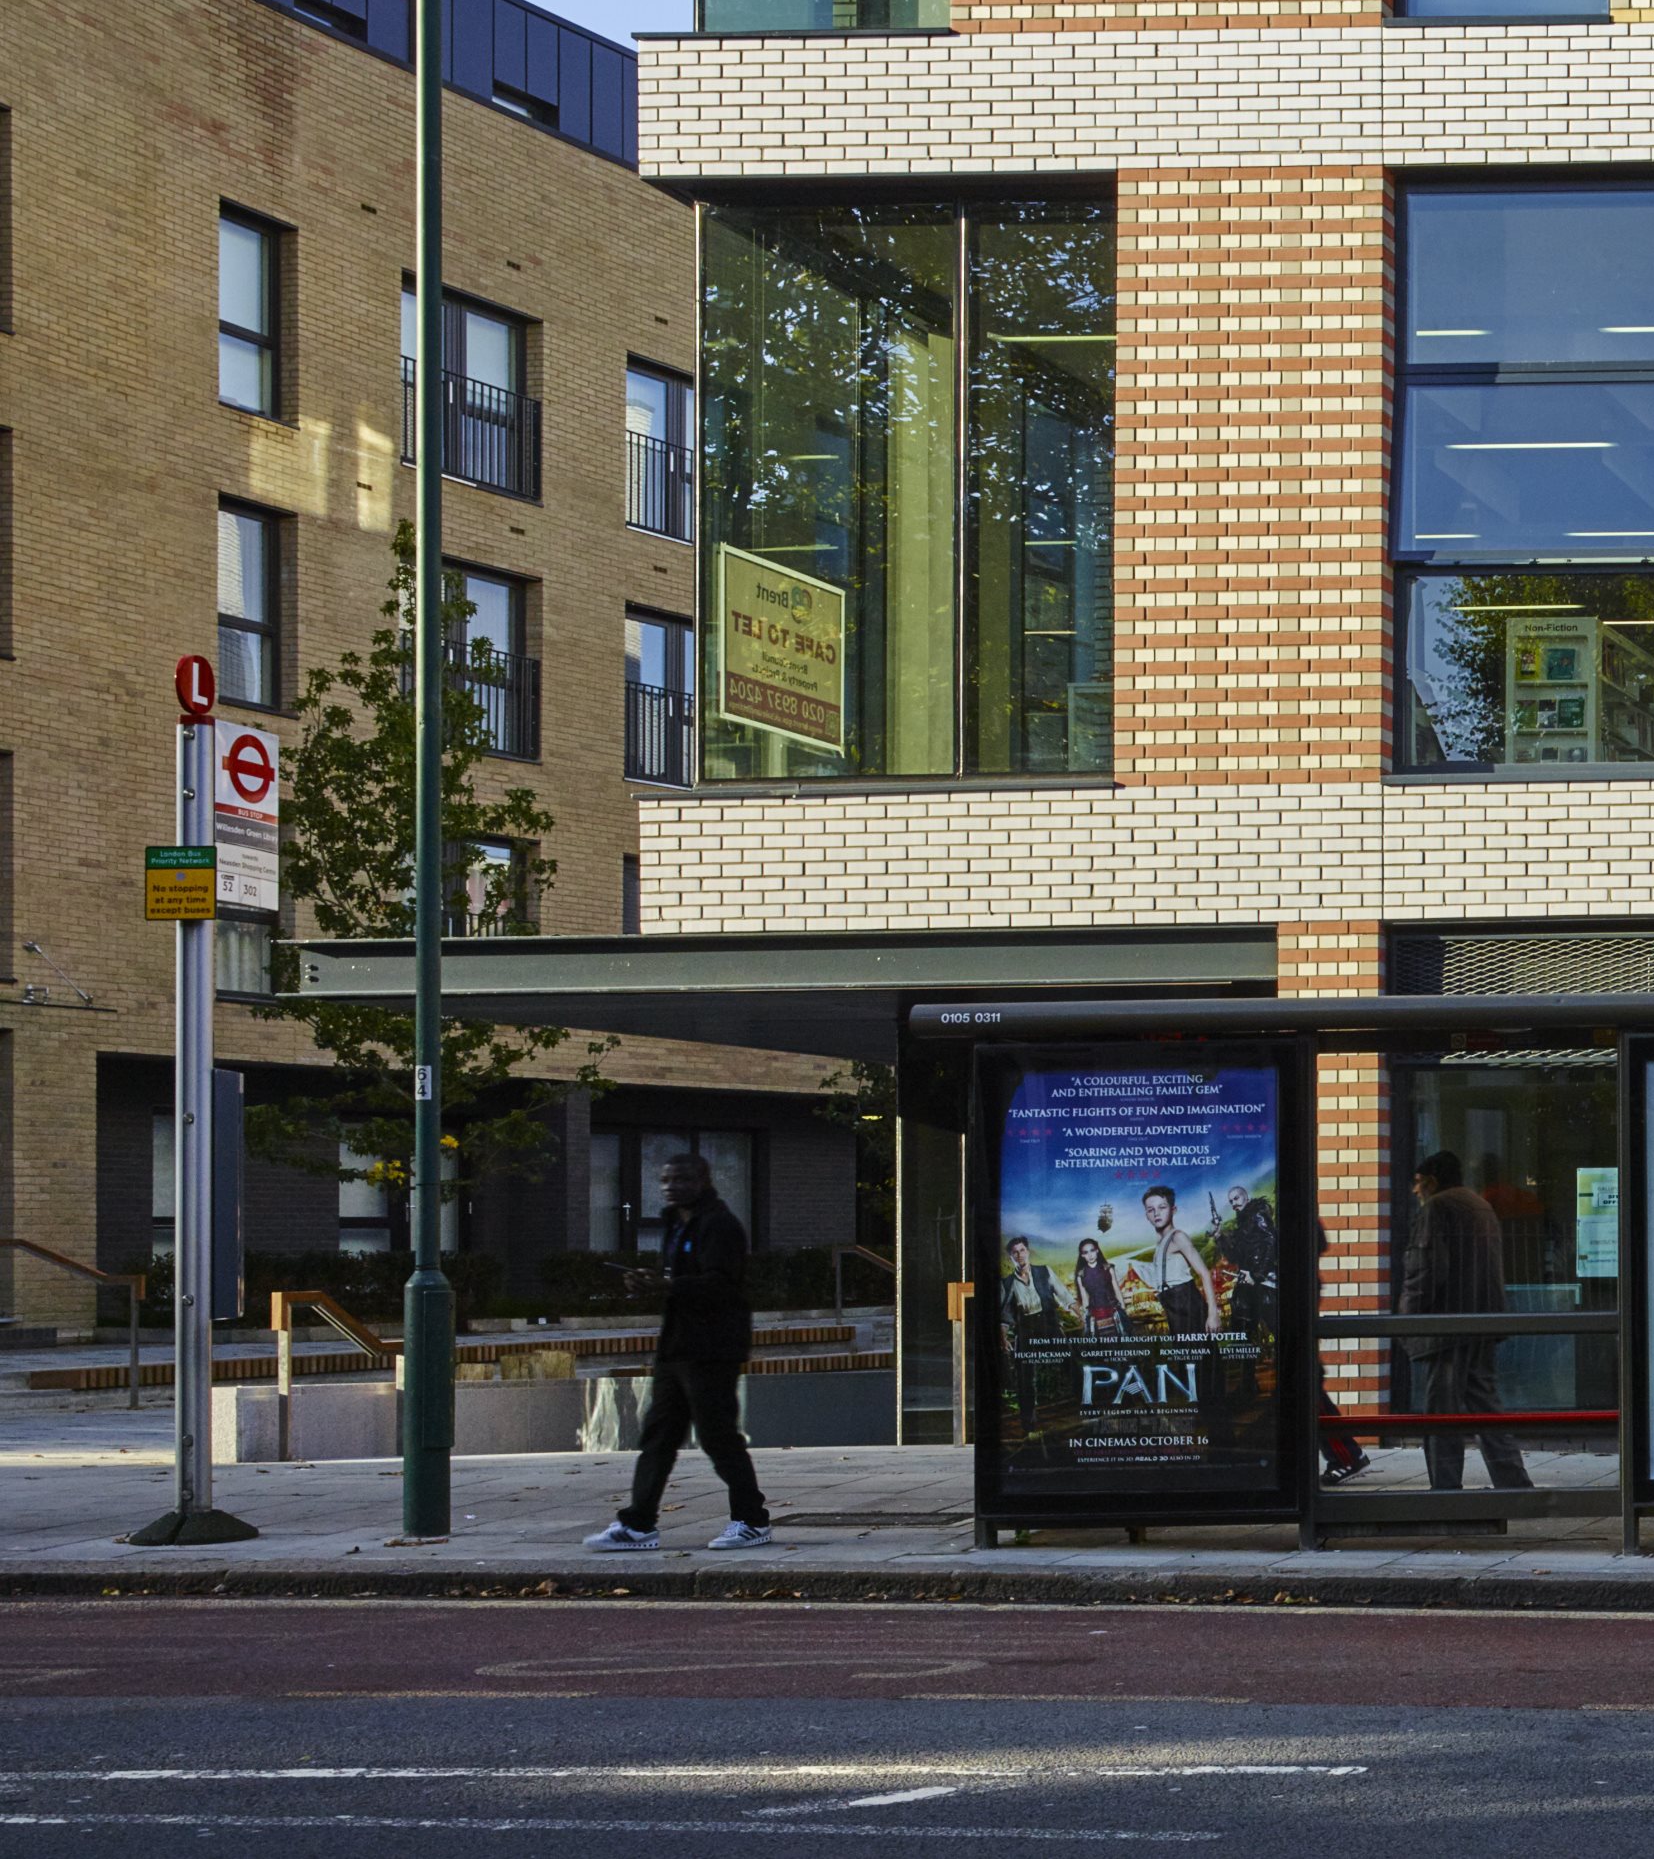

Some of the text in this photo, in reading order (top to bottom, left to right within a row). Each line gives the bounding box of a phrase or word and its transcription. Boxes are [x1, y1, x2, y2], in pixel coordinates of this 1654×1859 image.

[1525, 623, 1578, 632] Non-Fiction
[192, 661, 208, 706] L
[238, 808, 263, 819] BUS STOP
[215, 822, 245, 836] Willesden
[246, 828, 262, 839] Green
[242, 862, 262, 873] Shopping
[152, 884, 209, 893] No stopping
[223, 881, 233, 892] 52
[243, 884, 257, 896] 302
[167, 897, 183, 905] any
[186, 896, 207, 904] time
[150, 906, 211, 914] except buses
[941, 1012, 1001, 1023] 0105 0311
[1152, 1074, 1204, 1085] EXCITING
[1051, 1084, 1223, 1098] AND ENTHRALLING FAMILY GEM"
[1008, 1103, 1266, 1119] "FANTASTIC FLIGHTS OF FUN AND IMAGINATION"
[1075, 1125, 1144, 1137] WONDERFUL
[1145, 1124, 1212, 1135] ADVENTURE"
[1065, 1145, 1210, 1158] "SOARING AND WONDROUS
[1055, 1155, 1220, 1169] ENTERTAINMENT FOR ALL AGES"
[1029, 1332, 1248, 1345] FROM THE STUDIO THAT BROUGHT YOU HARRY POTTER
[1014, 1350, 1072, 1359] HUGH JACKMAN
[1081, 1349, 1151, 1357] GARRETT HEDLUND
[1159, 1348, 1190, 1356] ROONEY
[1237, 1346, 1261, 1354] MILLER
[1081, 1363, 1199, 1406] PAN
[1069, 1436, 1209, 1448] IN CINEMAS OCTOBER 16
